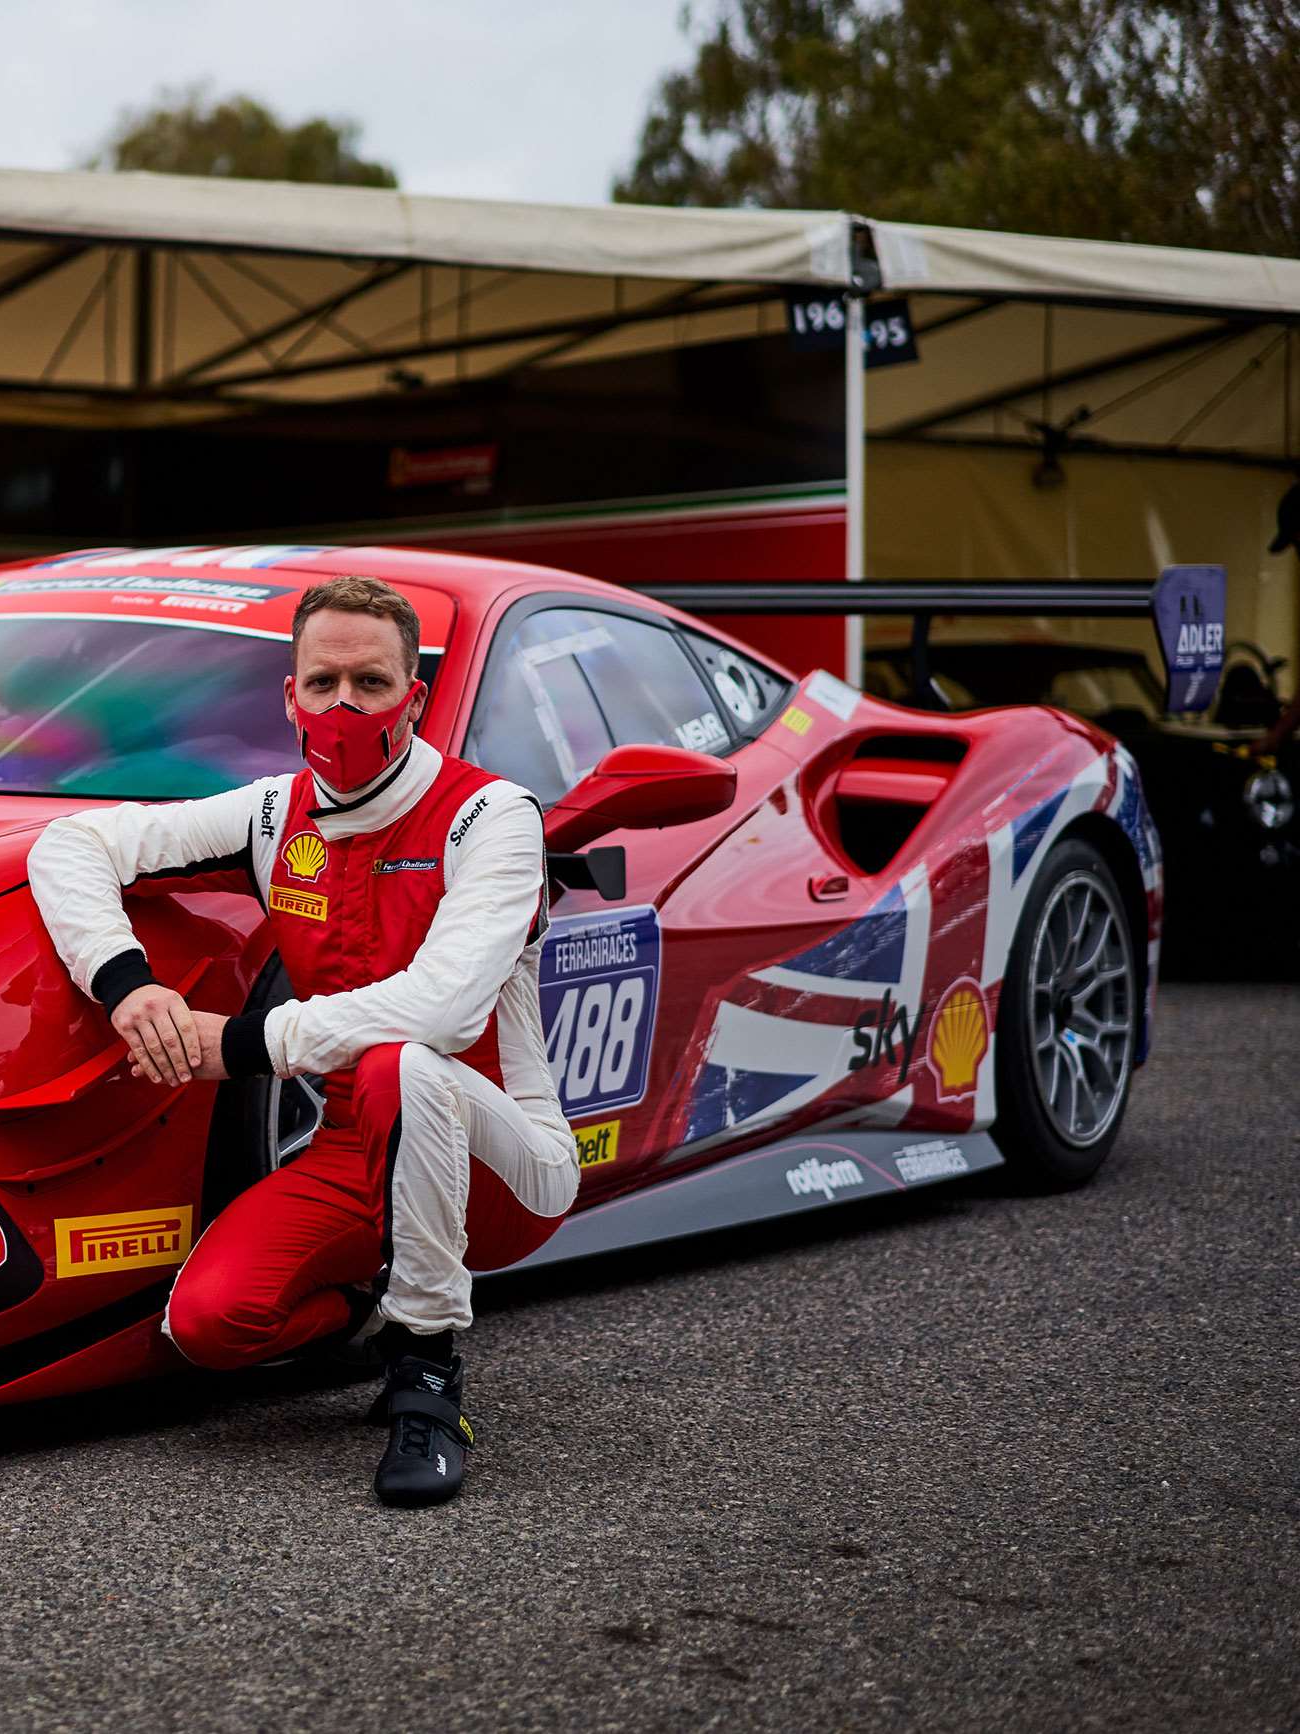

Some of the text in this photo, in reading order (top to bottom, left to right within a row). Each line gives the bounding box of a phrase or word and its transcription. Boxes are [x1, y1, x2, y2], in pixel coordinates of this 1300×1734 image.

[793, 301, 845, 334] 196
[861, 316, 908, 350] 95
[1176, 622, 1224, 654] ADLER
[261, 789, 279, 841] Sabelt
[450, 795, 490, 847] Sabelt
[273, 892, 324, 917] PIRELLI
[555, 932, 637, 975] FERRARIRACES
[545, 976, 645, 1101] 488
[847, 987, 928, 1085] sky
[69, 1218, 182, 1264] PIRELLI
